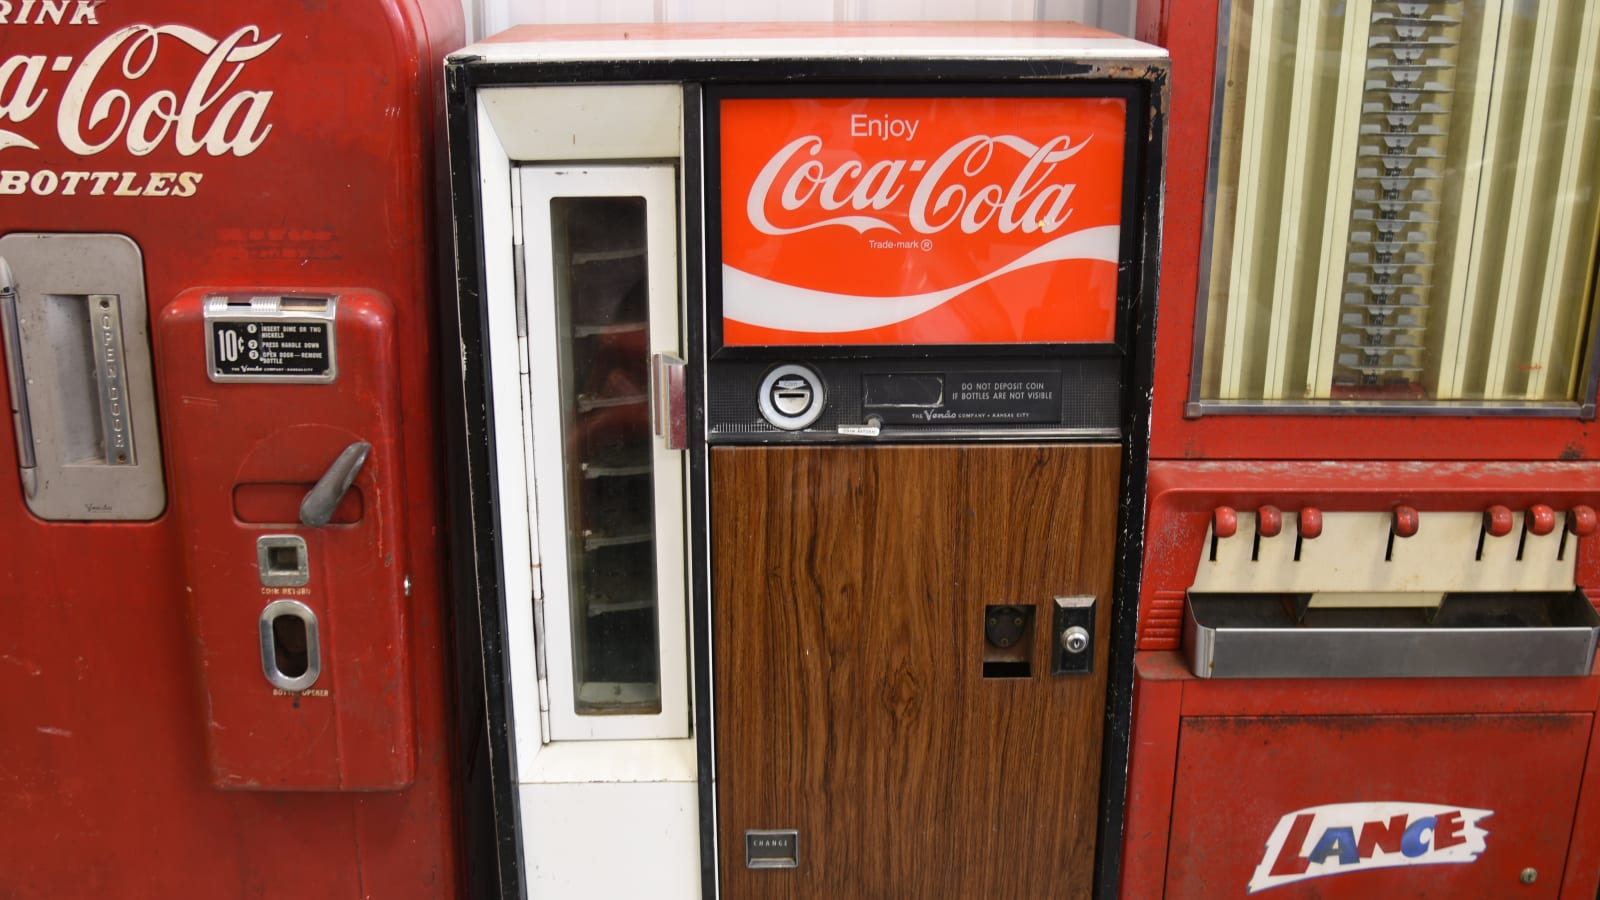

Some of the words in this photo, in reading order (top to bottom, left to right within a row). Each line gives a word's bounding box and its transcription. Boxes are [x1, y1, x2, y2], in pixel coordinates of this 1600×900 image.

[851, 114, 919, 141] Enjoy
[0, 170, 203, 197] BOTTLES
[746, 134, 1094, 236] Coca-Cola
[952, 392, 959, 400] IF
[961, 392, 990, 400] BOTTLES
[992, 392, 1007, 400] ARE
[1009, 392, 1025, 400] NOT
[1027, 391, 1053, 400] VISIBLE
[961, 382, 973, 391] DO
[976, 382, 992, 391] NOT
[994, 382, 1023, 391] DEPOSIT
[1025, 382, 1044, 390] COIN
[1268, 810, 1468, 877] LANCE
